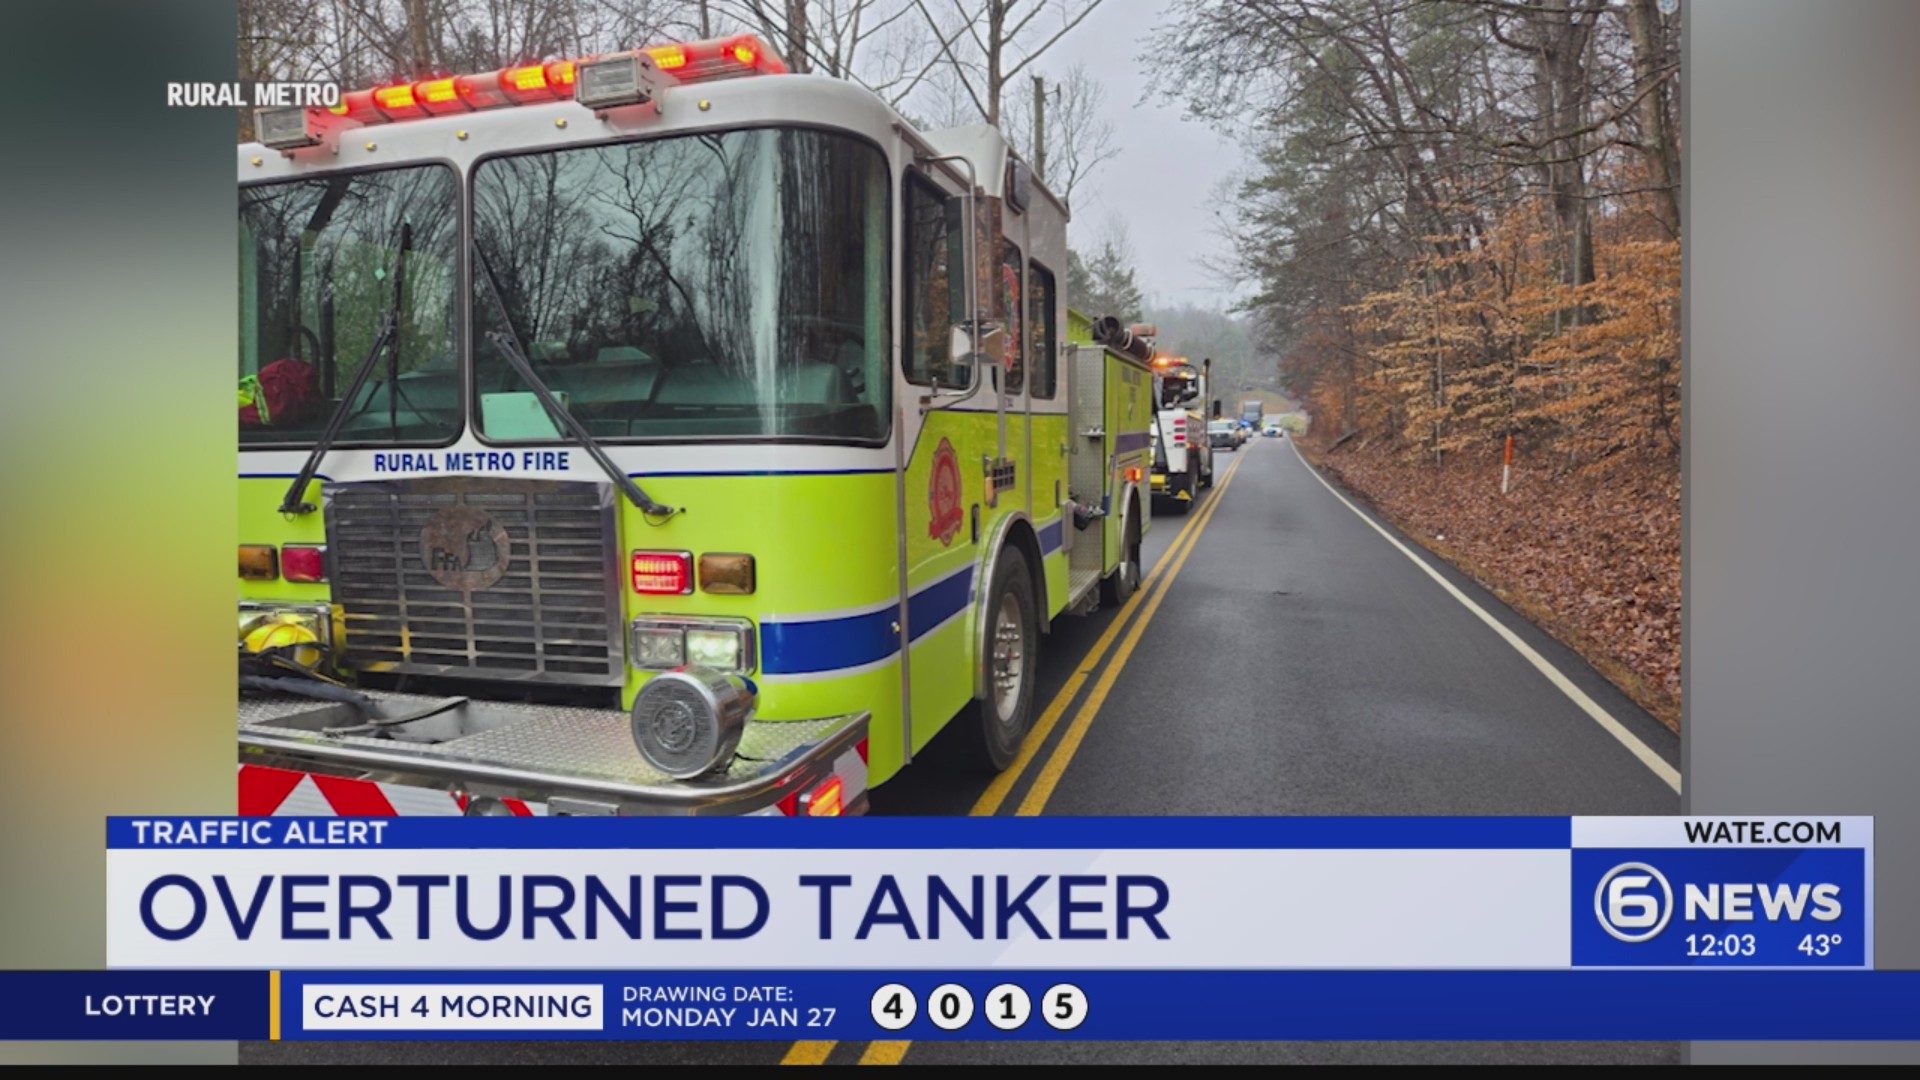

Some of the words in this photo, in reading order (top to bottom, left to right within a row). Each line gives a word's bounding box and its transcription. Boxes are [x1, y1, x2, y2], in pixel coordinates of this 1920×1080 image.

[374, 453, 439, 473] RURAL
[445, 452, 516, 472] METRO
[523, 451, 570, 471] FIRE
